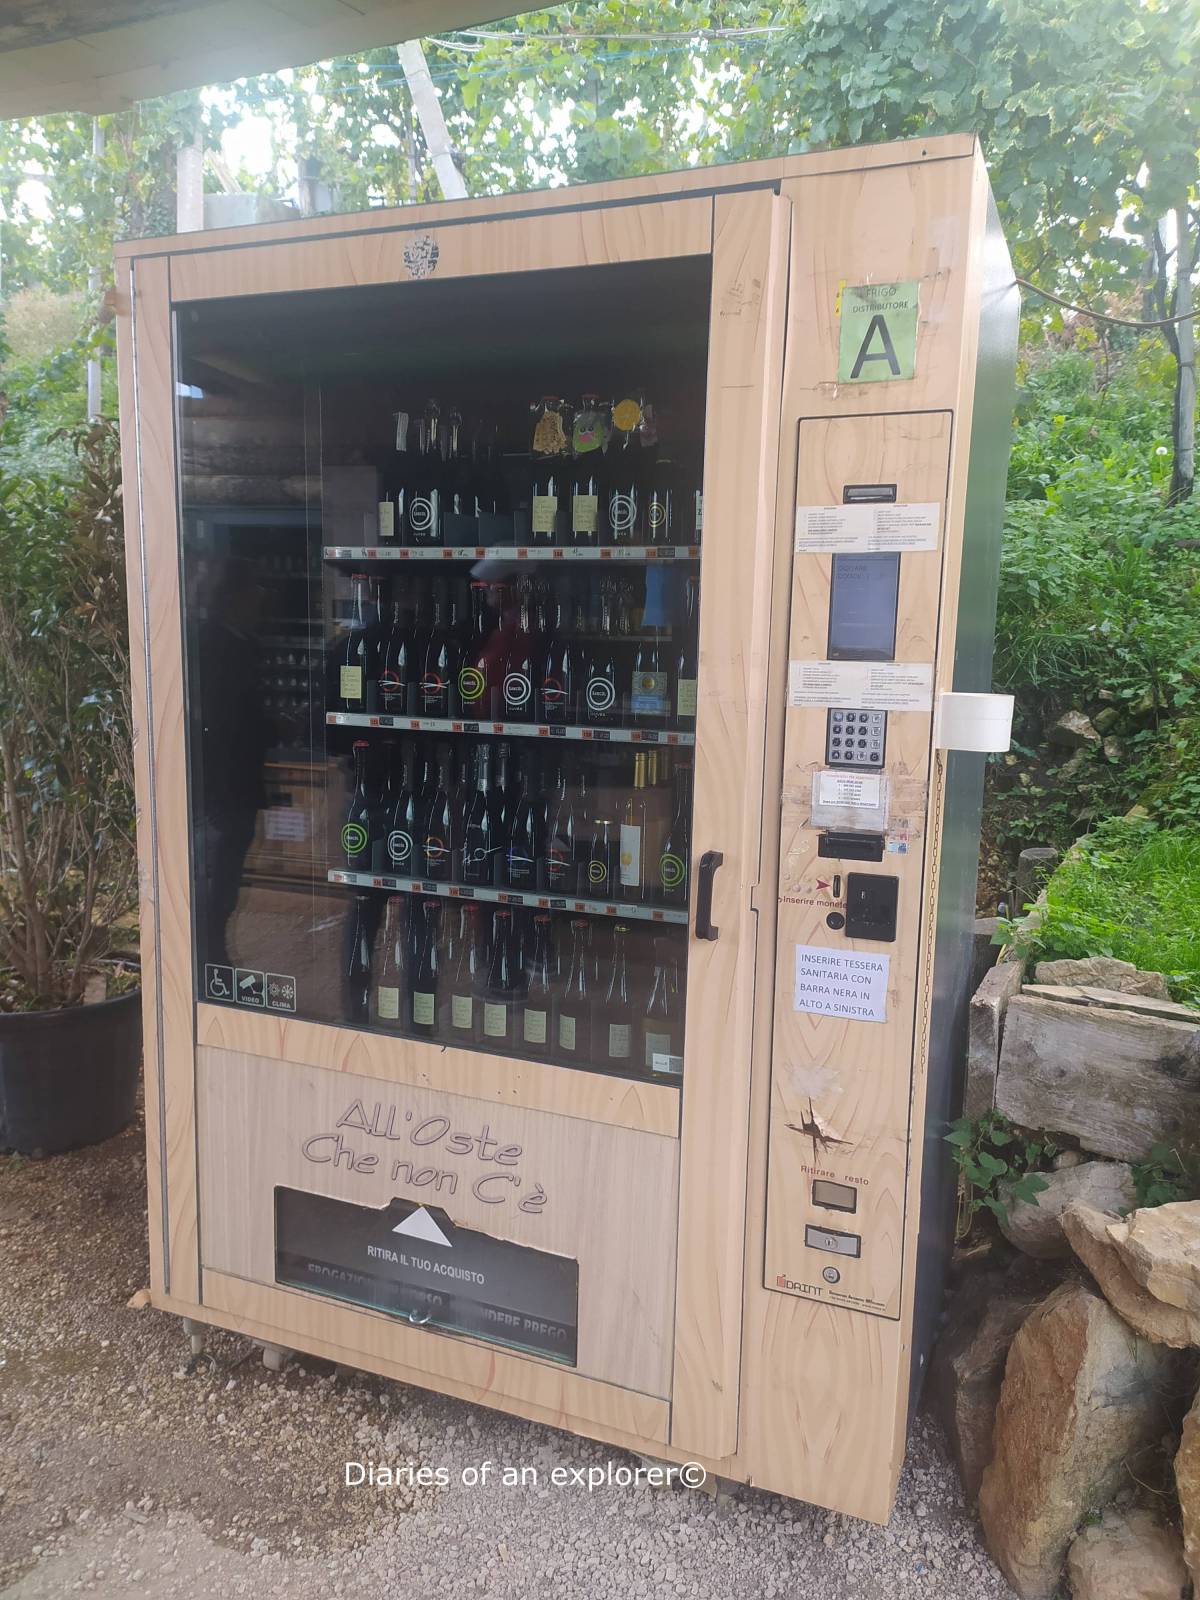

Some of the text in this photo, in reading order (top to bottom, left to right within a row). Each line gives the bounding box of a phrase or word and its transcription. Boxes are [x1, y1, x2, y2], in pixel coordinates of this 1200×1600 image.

[852, 301, 909, 313] DISTRIBUTORE
[850, 314, 901, 379] A
[783, 896, 815, 906] Inserire
[801, 954, 883, 972] INSERIRE TESSERA
[800, 967, 872, 985] SANITARIA CON
[241, 995, 260, 1004] VIDEO
[800, 983, 870, 1000] BARRA NERA IN
[272, 1001, 291, 1009] CLIMA
[799, 999, 875, 1017] ALTO A SINISTRA
[335, 1099, 523, 1165] All'Oste
[302, 1133, 548, 1214] Che non C'è
[800, 1165, 870, 1186] Ritirare resto
[367, 1245, 485, 1286] RITIRA IL TUO ACQUISTO
